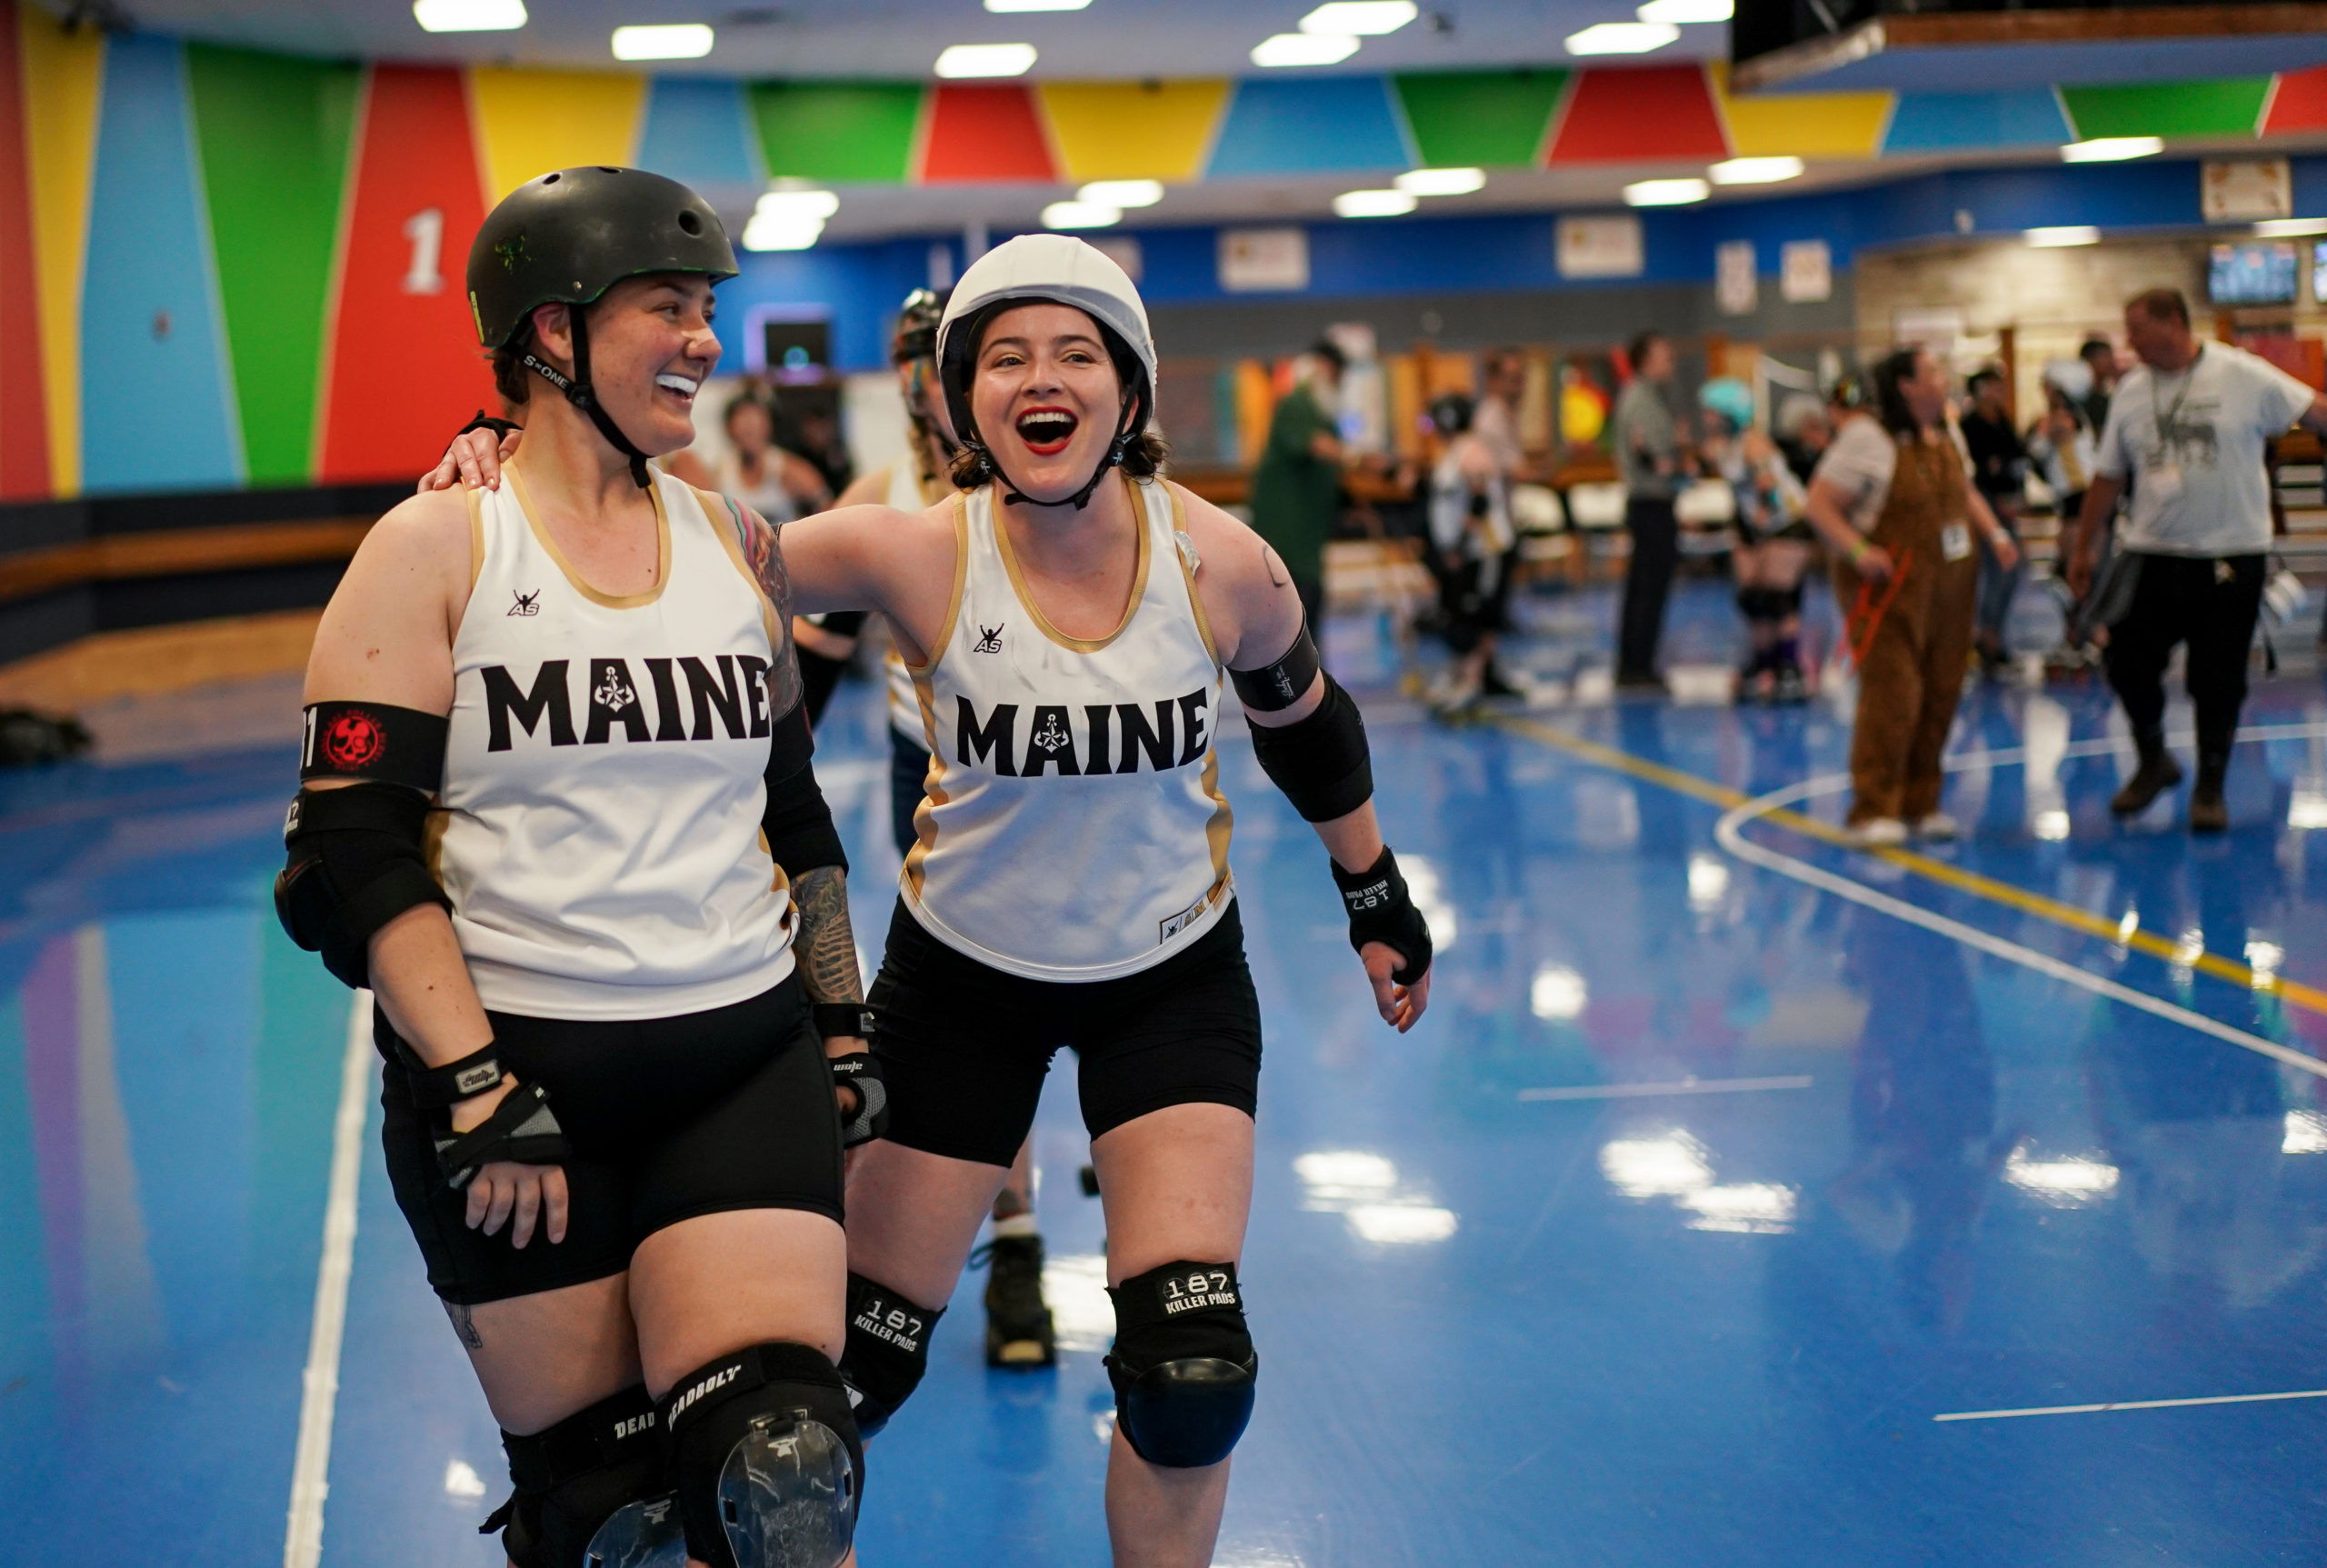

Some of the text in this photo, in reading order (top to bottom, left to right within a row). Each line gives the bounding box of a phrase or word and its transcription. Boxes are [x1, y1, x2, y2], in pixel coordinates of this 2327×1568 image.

[401, 209, 447, 296] 1
[480, 654, 771, 753] MAINE
[956, 686, 1209, 778] MAINE
[1353, 888, 1389, 910] 187
[1165, 1293, 1236, 1314] KILLER PADS
[1168, 1273, 1228, 1299] 187
[854, 1314, 918, 1352] KILLER PADS
[866, 1300, 923, 1336] 187
